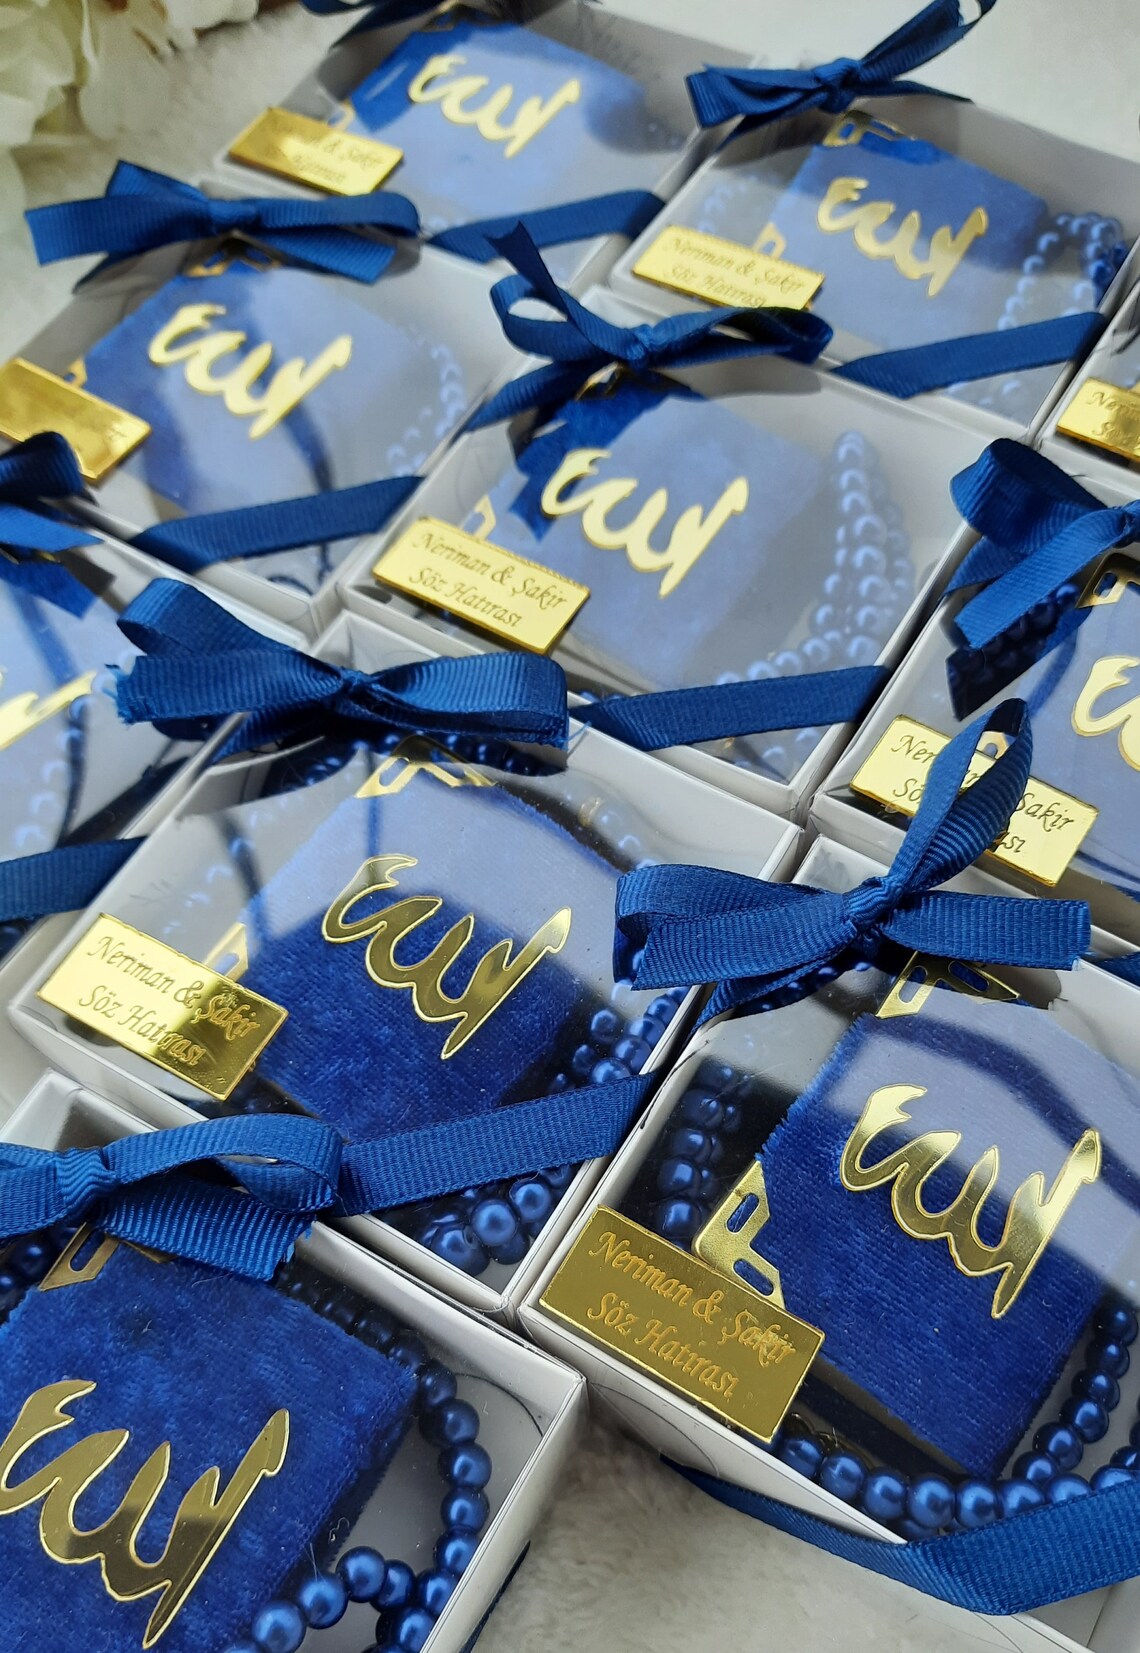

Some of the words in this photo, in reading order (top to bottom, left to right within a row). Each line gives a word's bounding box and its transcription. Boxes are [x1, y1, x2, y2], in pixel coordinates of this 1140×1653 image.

[409, 567, 445, 592] Söz
[445, 581, 523, 628] Hatırası
[412, 533, 491, 575] Neriman
[491, 566, 515, 587] &
[512, 577, 567, 611] Şakir
[78, 985, 124, 1018] Söz
[117, 1004, 207, 1066] Hatırası
[87, 935, 176, 994] Neriman
[173, 980, 205, 1009] &
[189, 992, 261, 1041] Şakir
[586, 1292, 640, 1336] Söz
[634, 1318, 740, 1398] Hatırası
[588, 1231, 694, 1308] Neriman
[692, 1289, 724, 1324] &
[717, 1309, 797, 1368] Şakir
